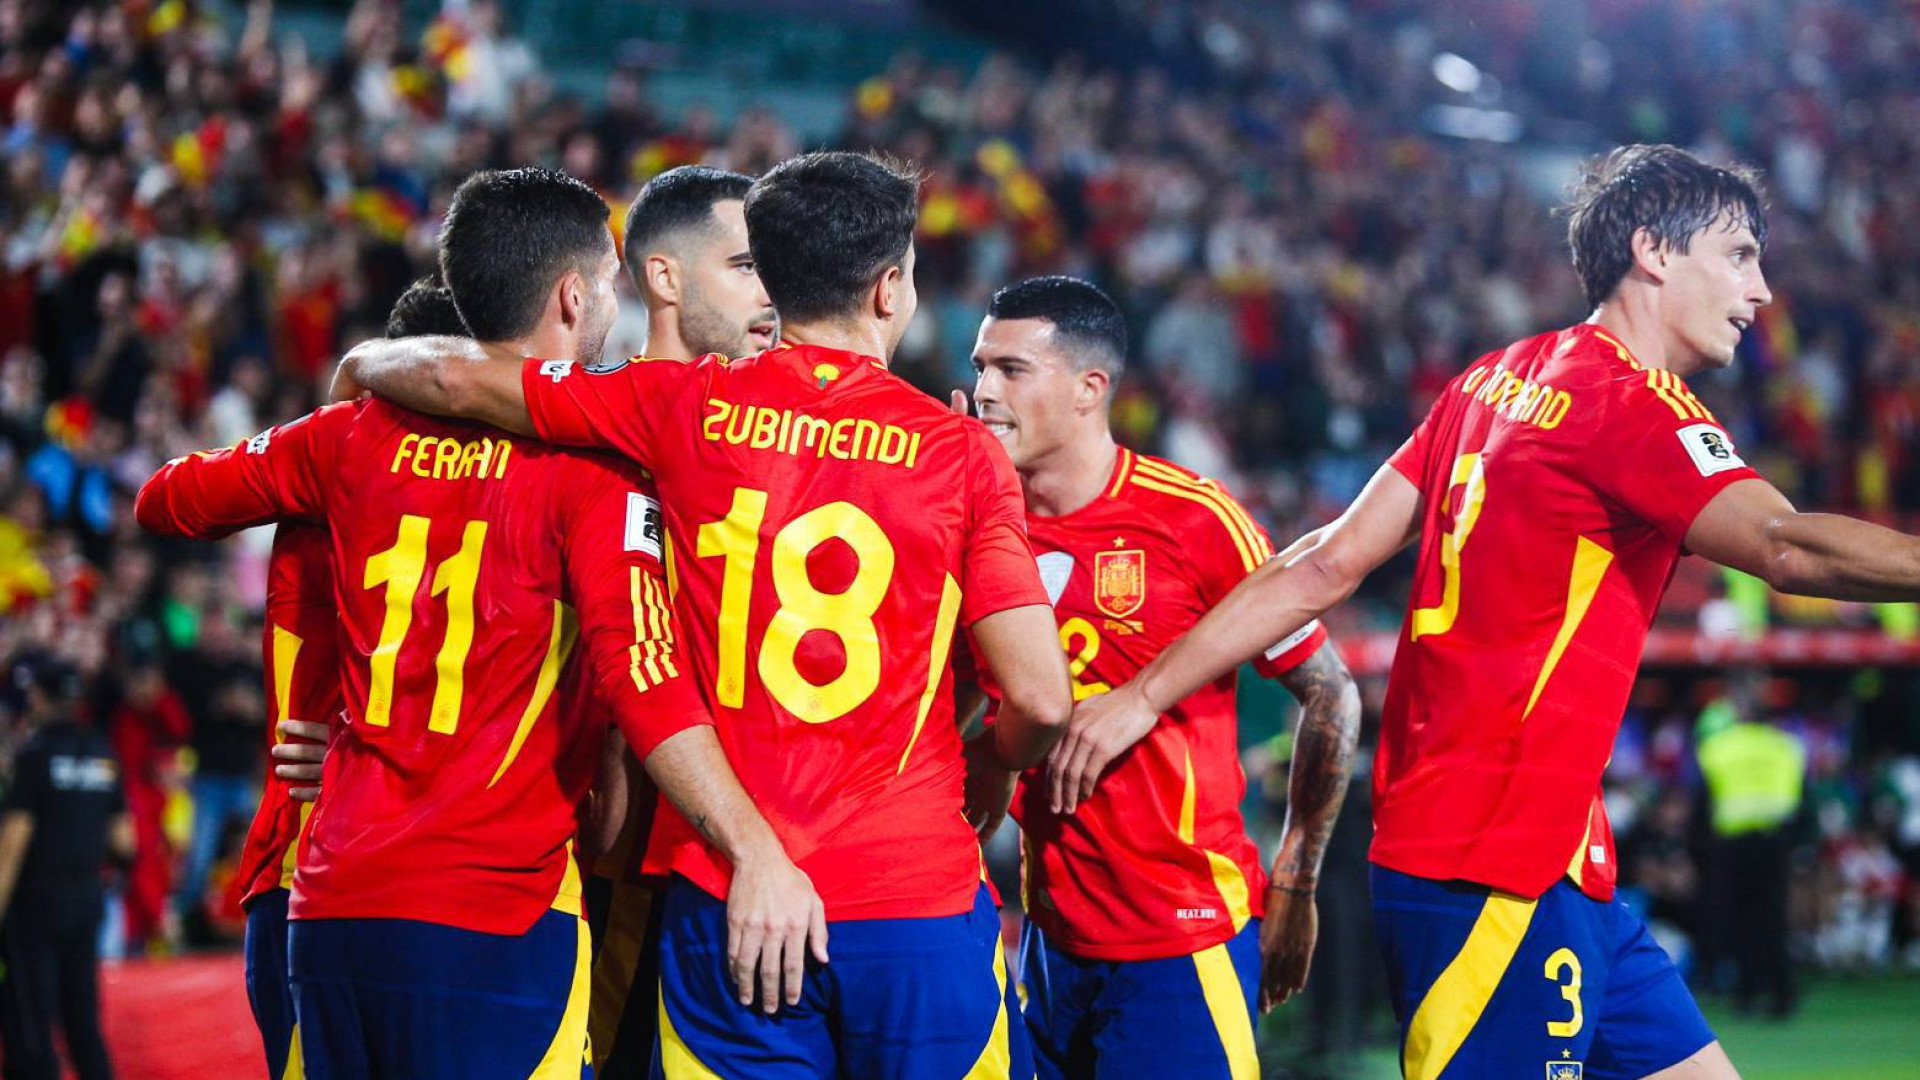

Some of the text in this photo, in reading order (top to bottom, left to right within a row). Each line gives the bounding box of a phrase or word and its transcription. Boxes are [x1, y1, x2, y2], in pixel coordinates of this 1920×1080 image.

[390, 433, 512, 480] FERRAN
[703, 398, 921, 468] ZUBIMENDI
[363, 514, 488, 735] 11
[696, 487, 895, 724] 18
[1059, 617, 1112, 701] 2
[1544, 947, 1584, 1038] 3
